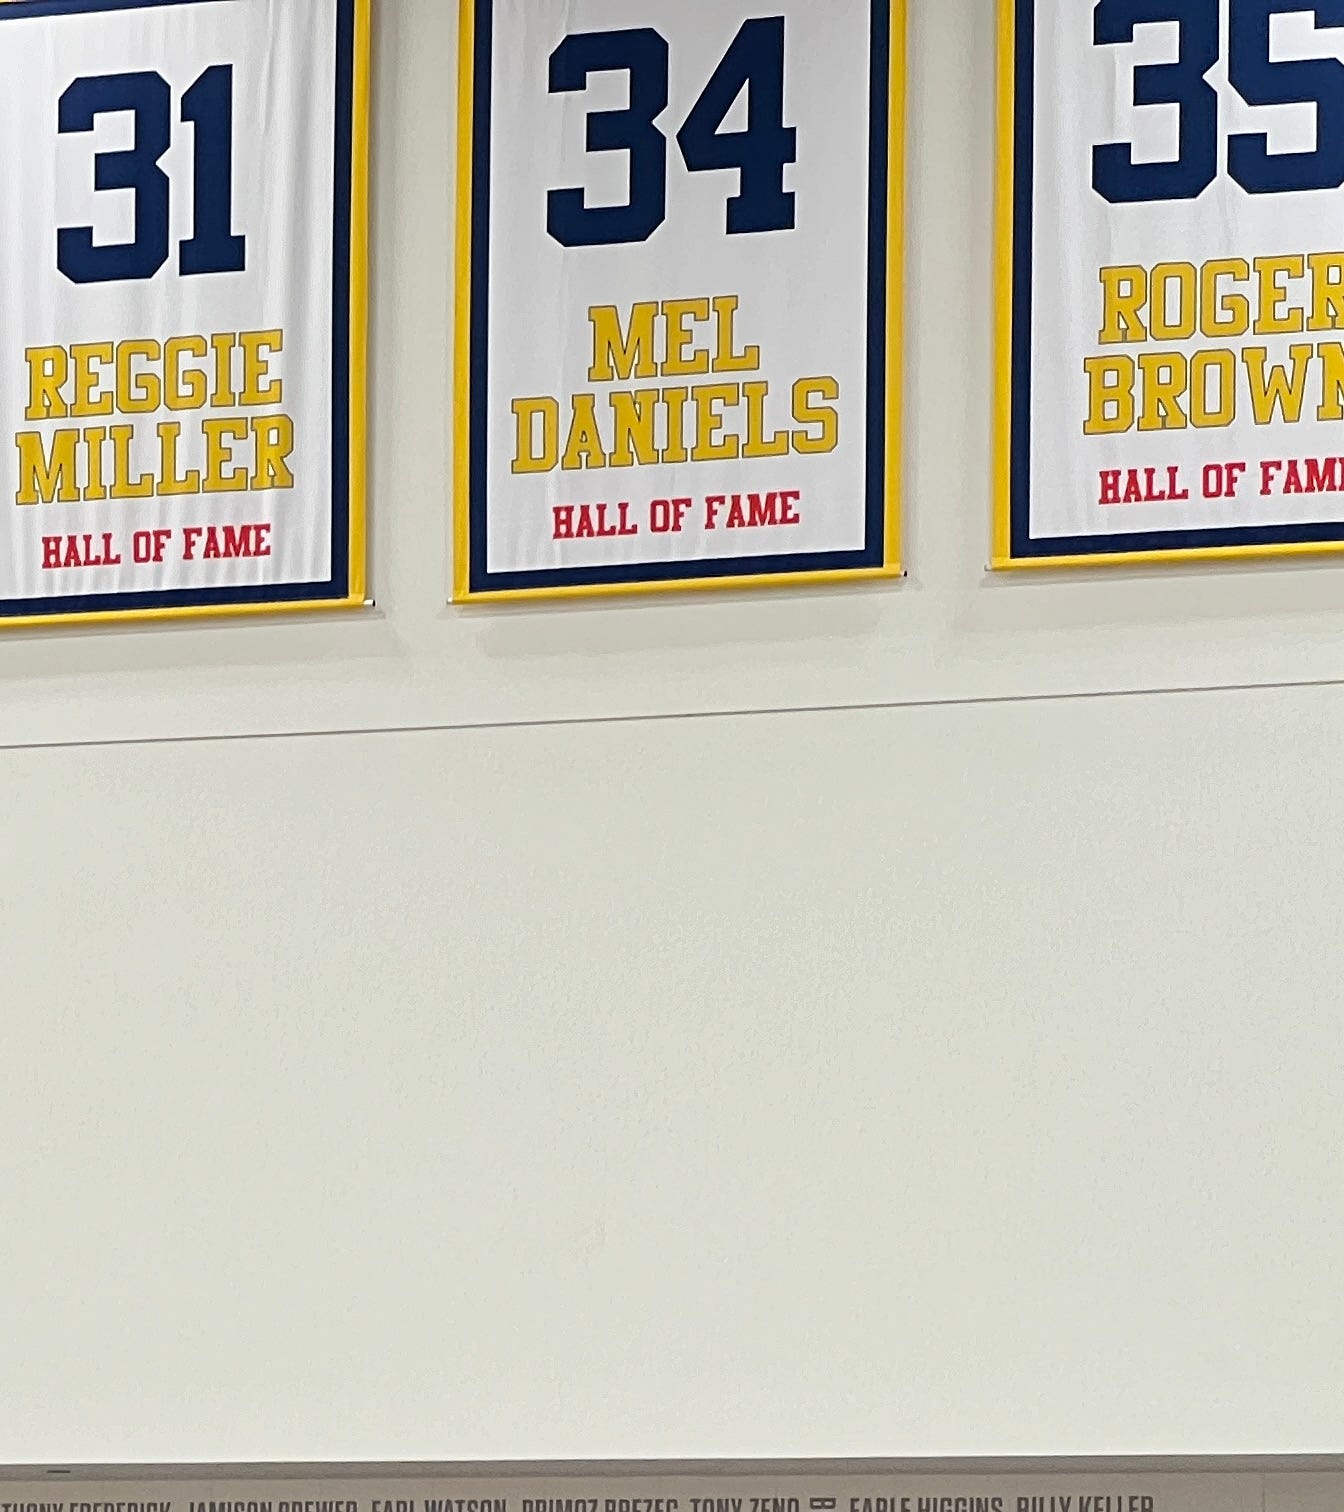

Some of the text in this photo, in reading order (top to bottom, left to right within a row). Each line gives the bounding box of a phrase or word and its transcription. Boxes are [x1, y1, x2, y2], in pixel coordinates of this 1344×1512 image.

[546, 15, 797, 248] 34
[1092, 0, 1344, 203] 35
[57, 64, 245, 284] 31
[588, 294, 760, 382] MEL
[1098, 251, 1344, 345] ROGER
[24, 328, 283, 421] REGGIE
[15, 414, 294, 506] MILLER
[511, 376, 840, 475] DANIELS
[552, 490, 800, 540] HALL OF FAME
[1098, 465, 1189, 505] HALL
[1201, 462, 1246, 499] OF
[41, 523, 271, 569] HALL OF FAME
